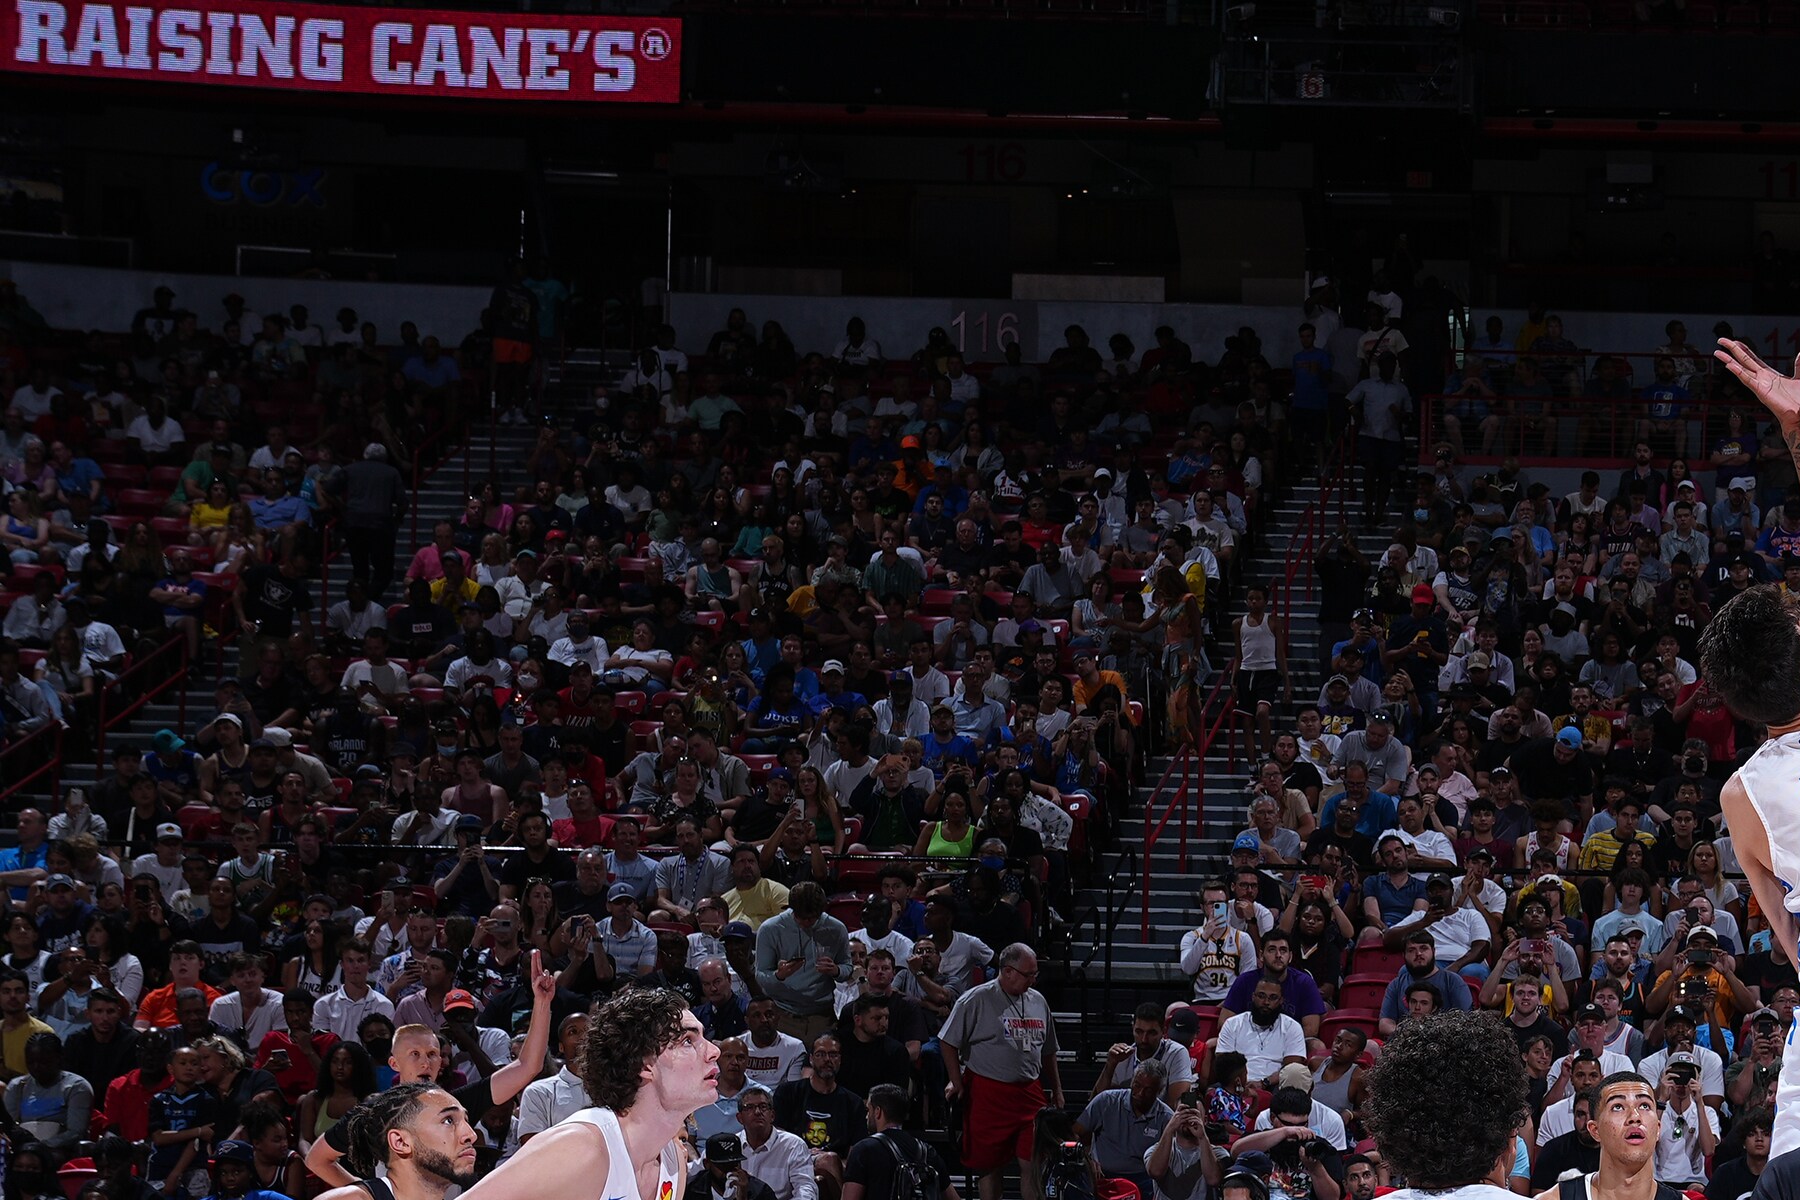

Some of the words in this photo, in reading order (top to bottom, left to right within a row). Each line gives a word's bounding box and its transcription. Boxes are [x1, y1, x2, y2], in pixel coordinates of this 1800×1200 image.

[15, 0, 345, 84] RAISING
[958, 144, 1026, 181] 116
[200, 160, 326, 207] COX
[952, 311, 1020, 353] 116
[1199, 954, 1237, 969] SONICS
[1210, 973, 1229, 989] 34
[1012, 1020, 1044, 1029] SUMMER
[747, 1058, 778, 1069] UNRISE
